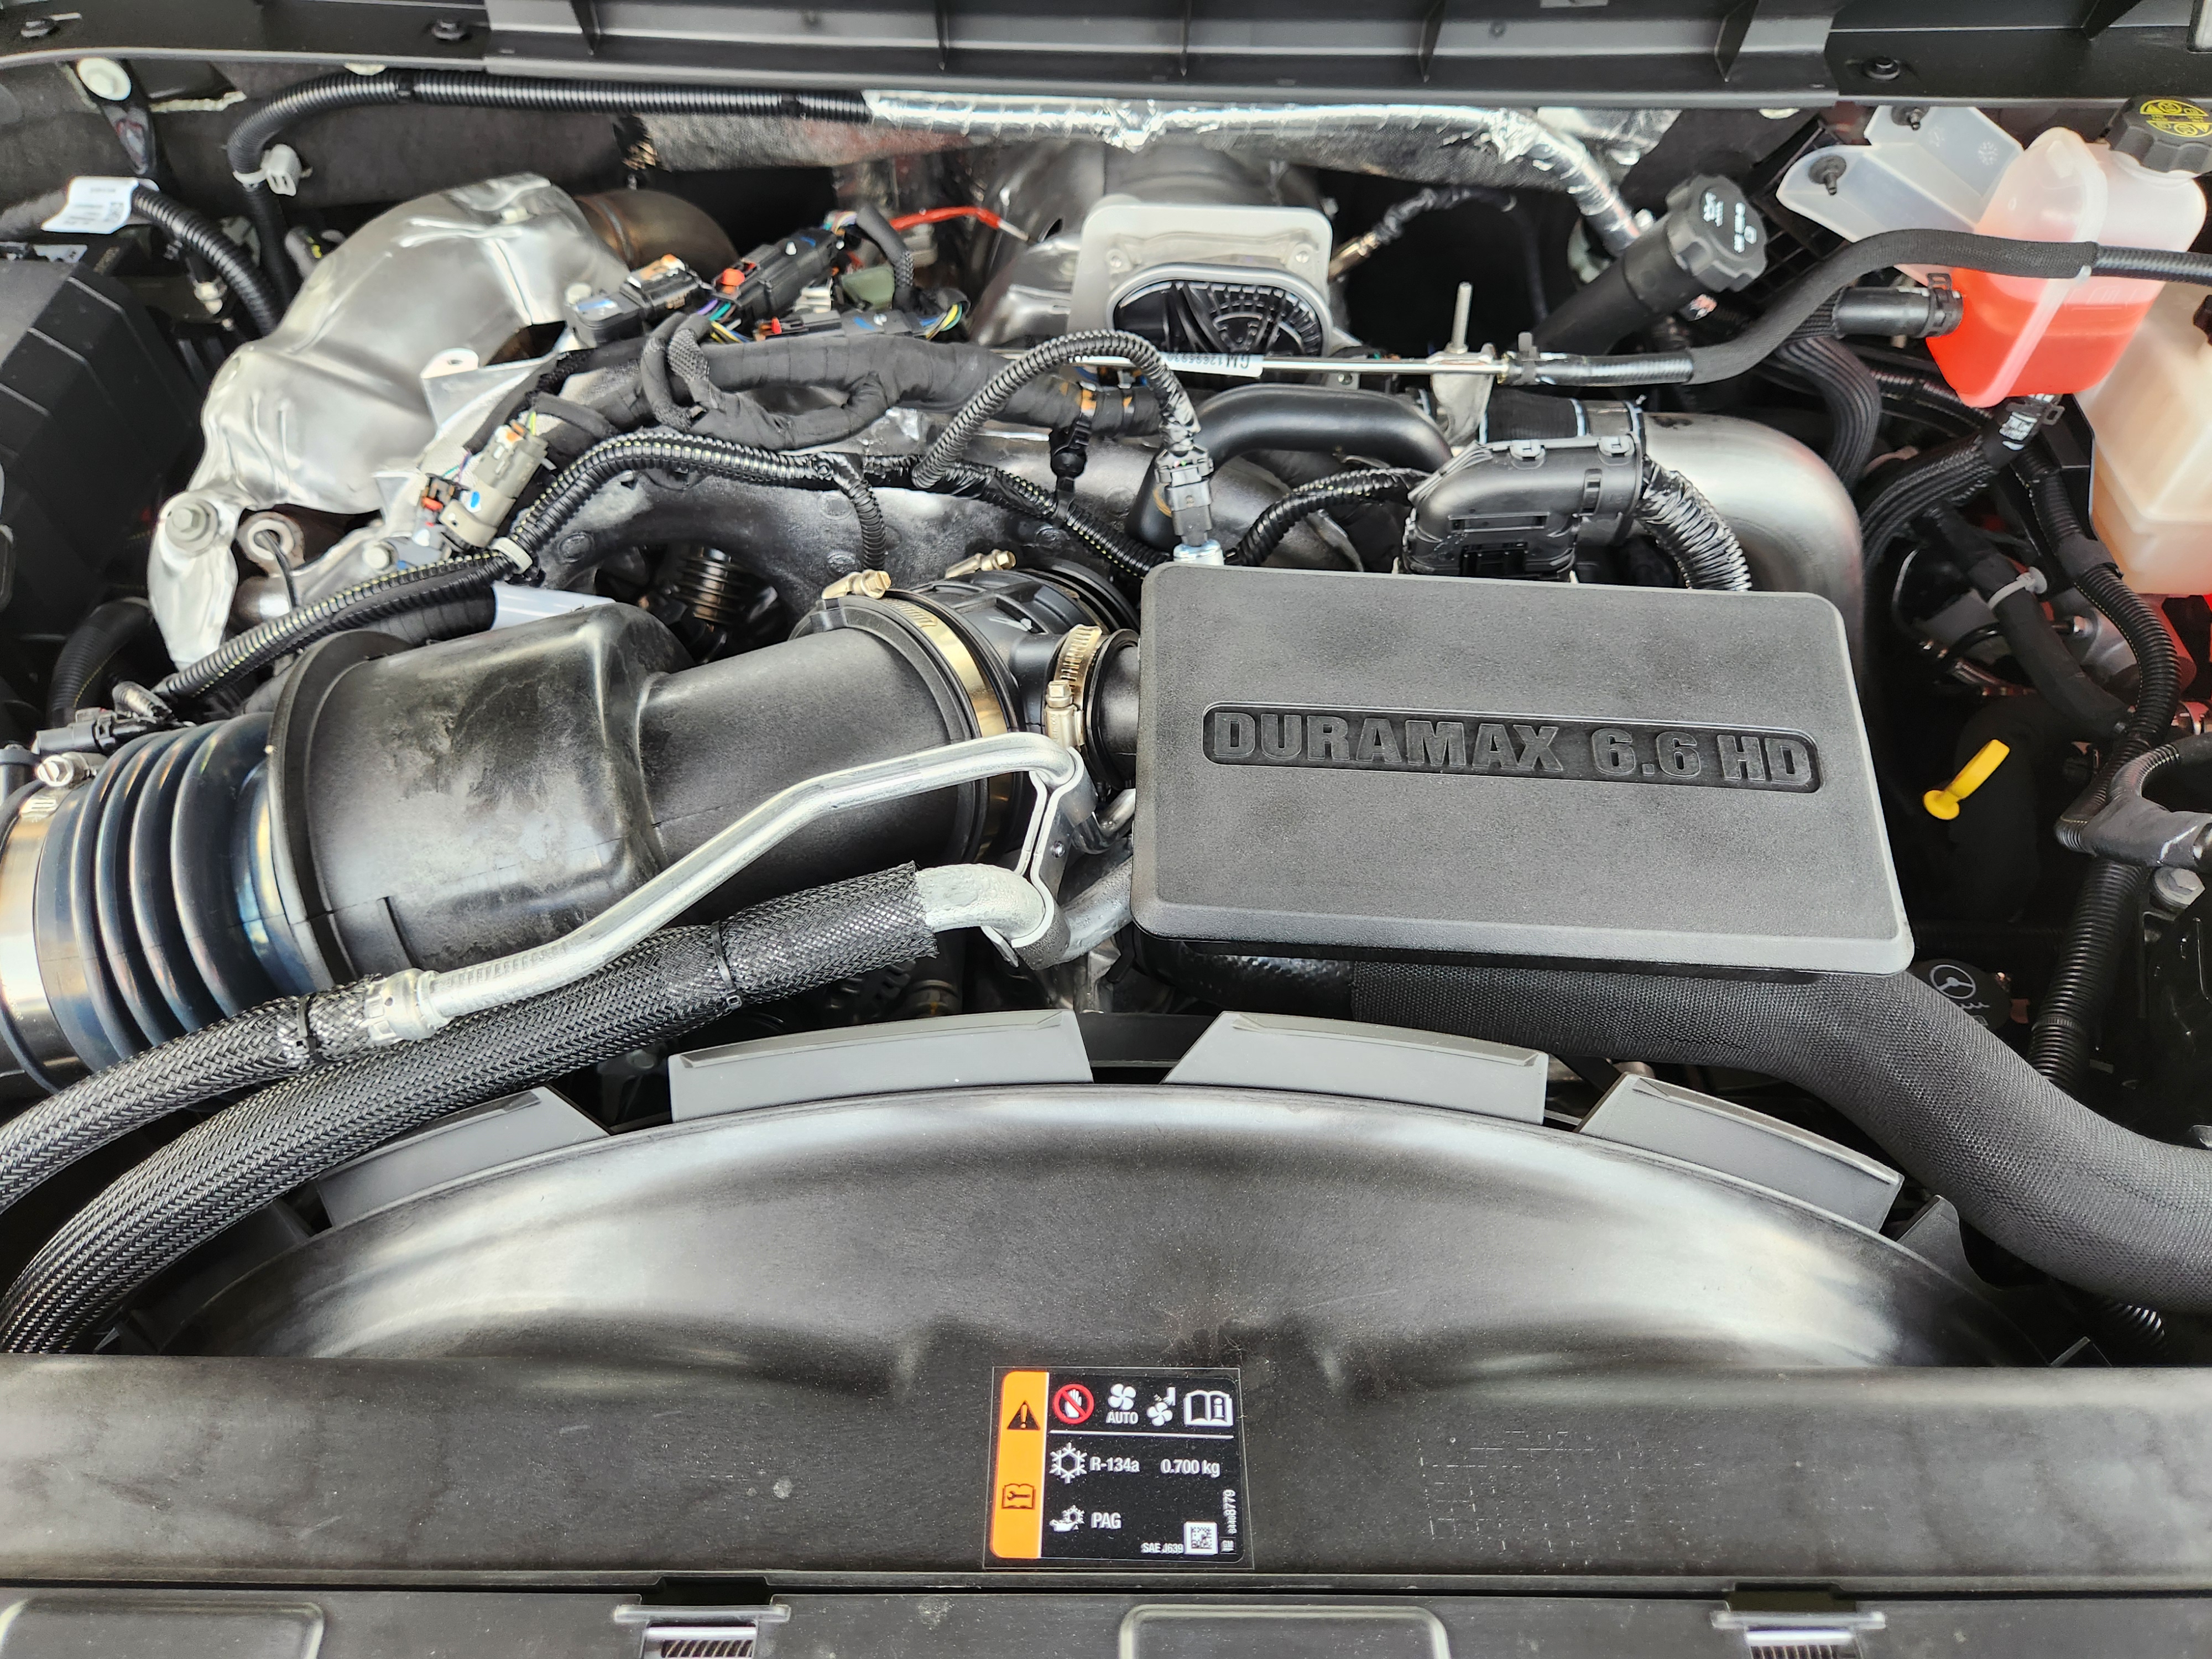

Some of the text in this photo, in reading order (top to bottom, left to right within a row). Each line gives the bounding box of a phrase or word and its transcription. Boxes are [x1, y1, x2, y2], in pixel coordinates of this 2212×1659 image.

[1214, 712, 1814, 786] DURAMAX 6.6 HD
[1106, 1412, 1139, 1425] AUTO
[1089, 1458, 1140, 1472] R-134a
[1161, 1459, 1220, 1478] 0.700 kg
[1091, 1512, 1122, 1529] PAG
[1141, 1542, 1184, 1554] SAE J639
[1221, 1540, 1234, 1550] GM
